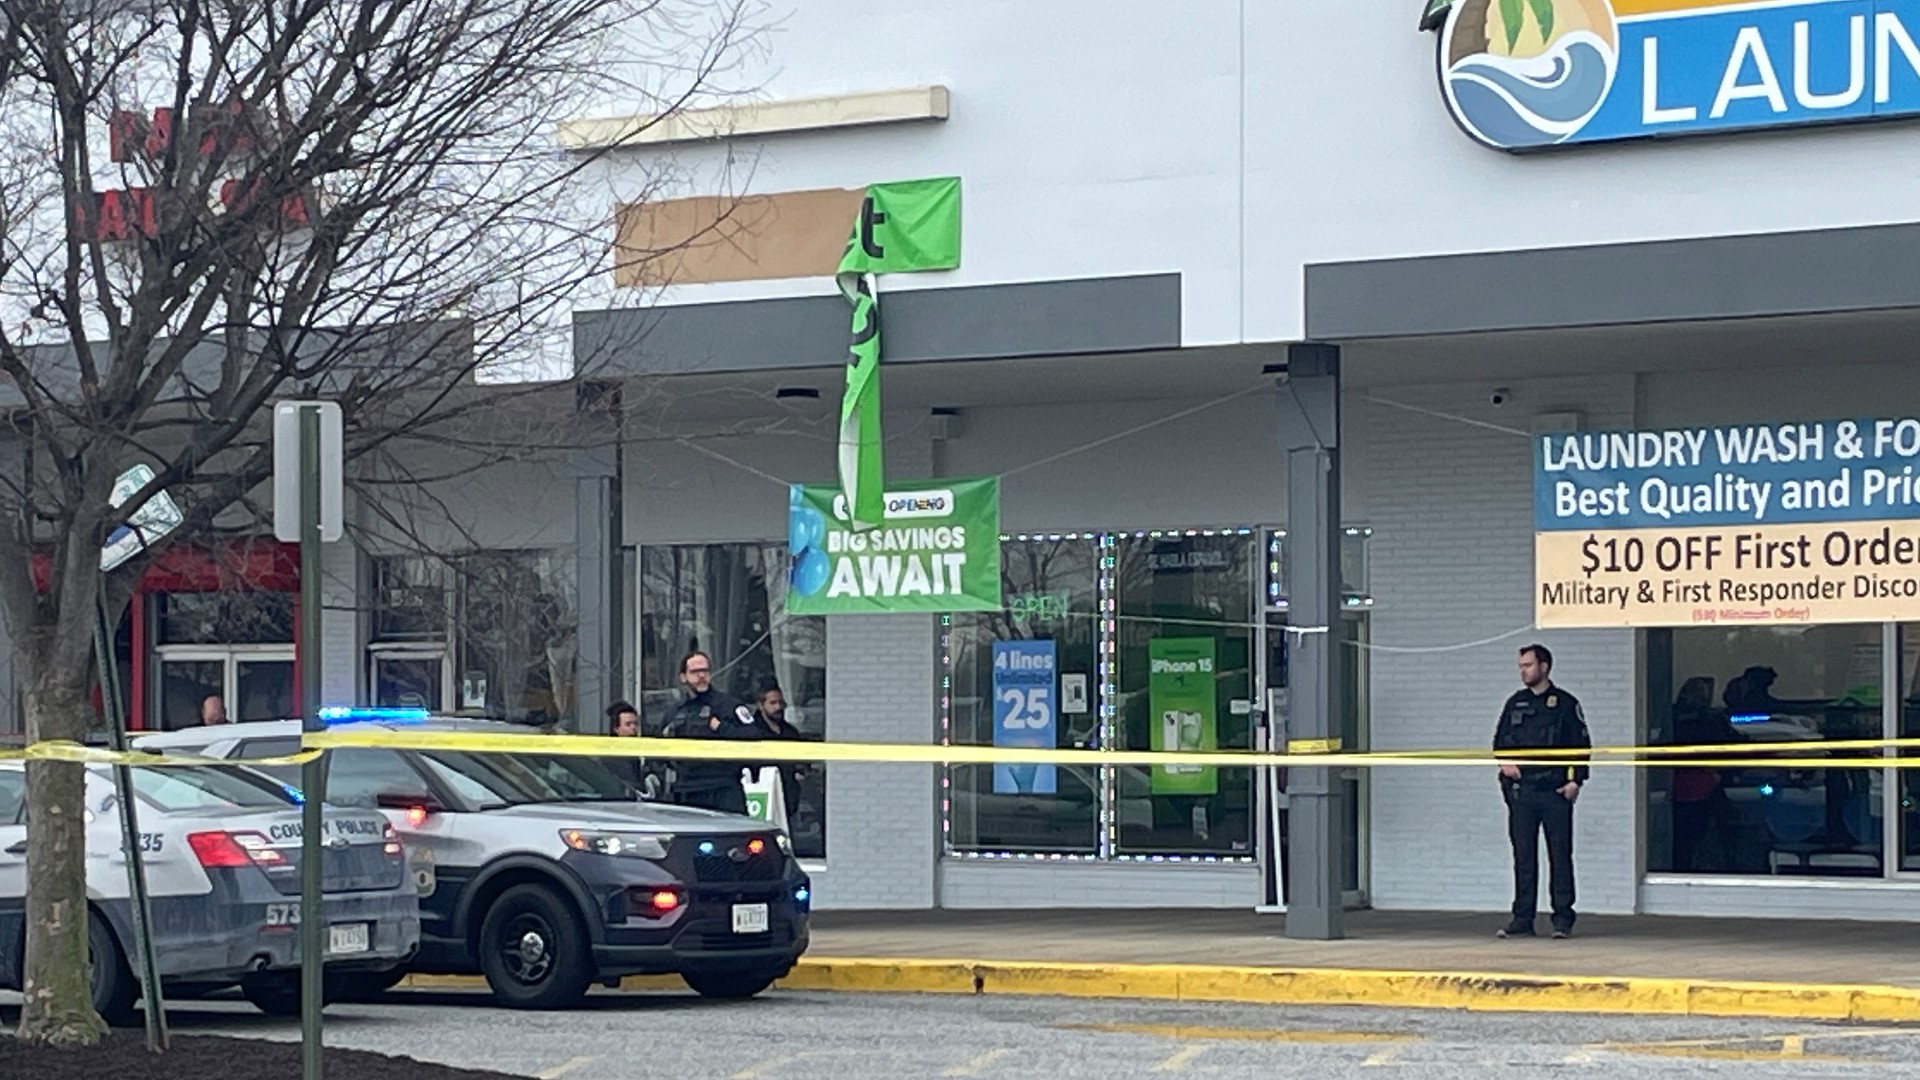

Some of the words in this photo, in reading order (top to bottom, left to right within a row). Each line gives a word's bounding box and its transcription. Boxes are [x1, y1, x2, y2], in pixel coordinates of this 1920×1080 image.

[1543, 430, 1707, 471] LAUNDRY
[1714, 423, 1824, 465] WASH
[1834, 421, 1864, 459] &
[1556, 481, 1630, 517] Best
[1640, 472, 1772, 519] Quality
[1781, 468, 1850, 510] and
[828, 531, 867, 553] BIG
[870, 526, 966, 550] SAVINGS
[1582, 533, 1644, 578] $10
[1656, 536, 1723, 572] OFF
[1735, 532, 1811, 569] First
[1823, 527, 1920, 567] Orde
[826, 552, 967, 598] AWAIT
[1542, 579, 1630, 610] Military
[1637, 579, 1655, 603] &
[1662, 578, 1712, 603] First
[1719, 574, 1846, 607] Responder
[1011, 590, 1069, 622] OPEN
[995, 651, 1008, 671] 4
[1010, 650, 1053, 670] lines
[1151, 658, 1197, 674] iPhone
[1198, 658, 1213, 673] 15
[336, 819, 380, 835] POLICE
